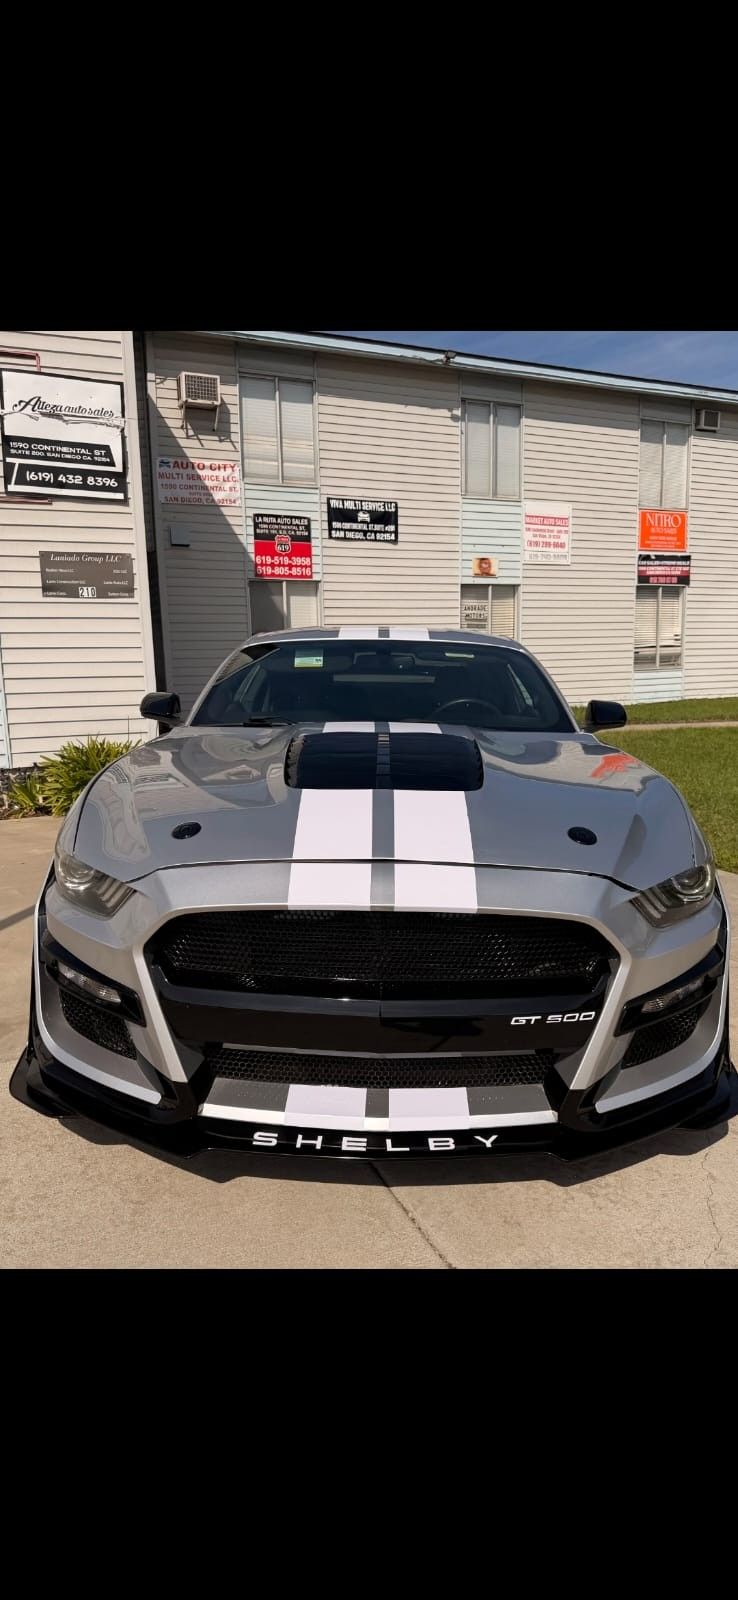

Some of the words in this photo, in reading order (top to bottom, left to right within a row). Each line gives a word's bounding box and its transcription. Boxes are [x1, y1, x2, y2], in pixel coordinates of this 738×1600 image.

[10, 441, 30, 449] 1590
[31, 442, 92, 455] CONTINENTAL
[172, 460, 206, 471] AUTO
[209, 463, 237, 472] CITY
[26, 470, 54, 484] (619)
[58, 474, 83, 484] 432
[86, 476, 118, 488] 8396
[158, 472, 184, 480] MULTI
[186, 474, 220, 482] SERVICE
[178, 484, 226, 492] CONTINENTAL
[330, 499, 343, 508] VIVA
[344, 500, 360, 510] MULTI
[362, 501, 384, 512] SERVICE
[385, 502, 396, 512] LLC
[646, 512, 682, 528] NITRO
[82, 554, 104, 564] Group
[105, 554, 122, 562] LLC
[256, 555, 311, 566] 619-519-3958
[256, 566, 311, 576] 619-805-8516
[80, 587, 96, 597] 210
[510, 1016, 542, 1026] GT
[545, 1011, 596, 1024] 500
[252, 1132, 499, 1152] SHELBY
